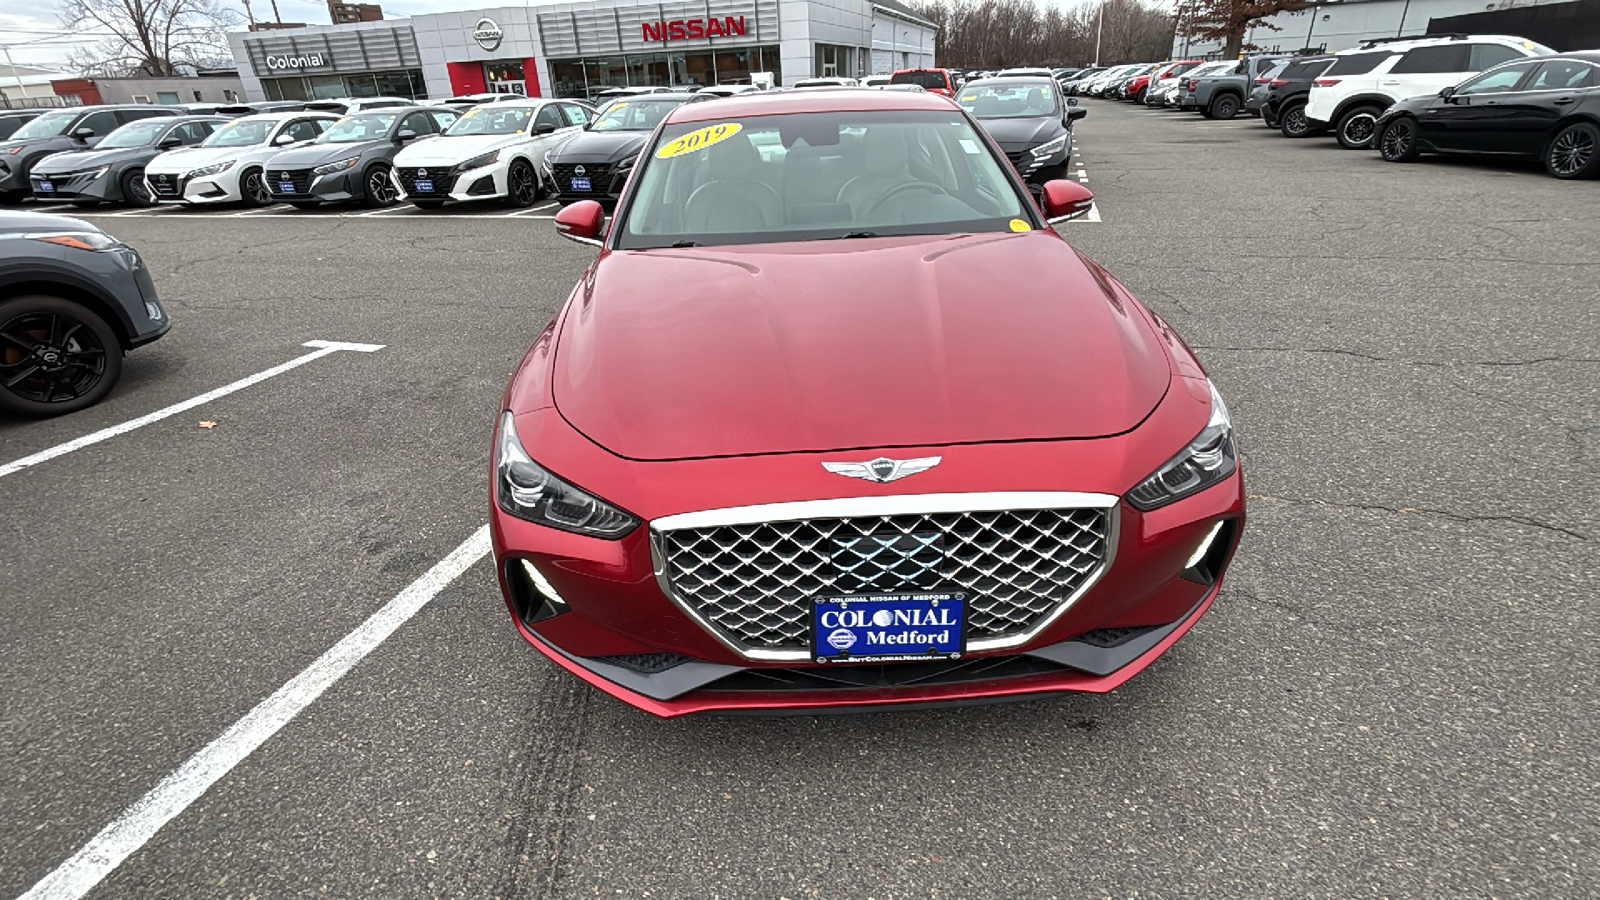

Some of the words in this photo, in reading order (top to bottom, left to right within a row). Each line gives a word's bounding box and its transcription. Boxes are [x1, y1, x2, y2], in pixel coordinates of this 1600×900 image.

[641, 16, 745, 42] NISSAN
[266, 53, 324, 69] Colonial
[674, 126, 726, 154] 2019
[821, 609, 957, 628] COLONIAL
[866, 630, 949, 645] Medford
